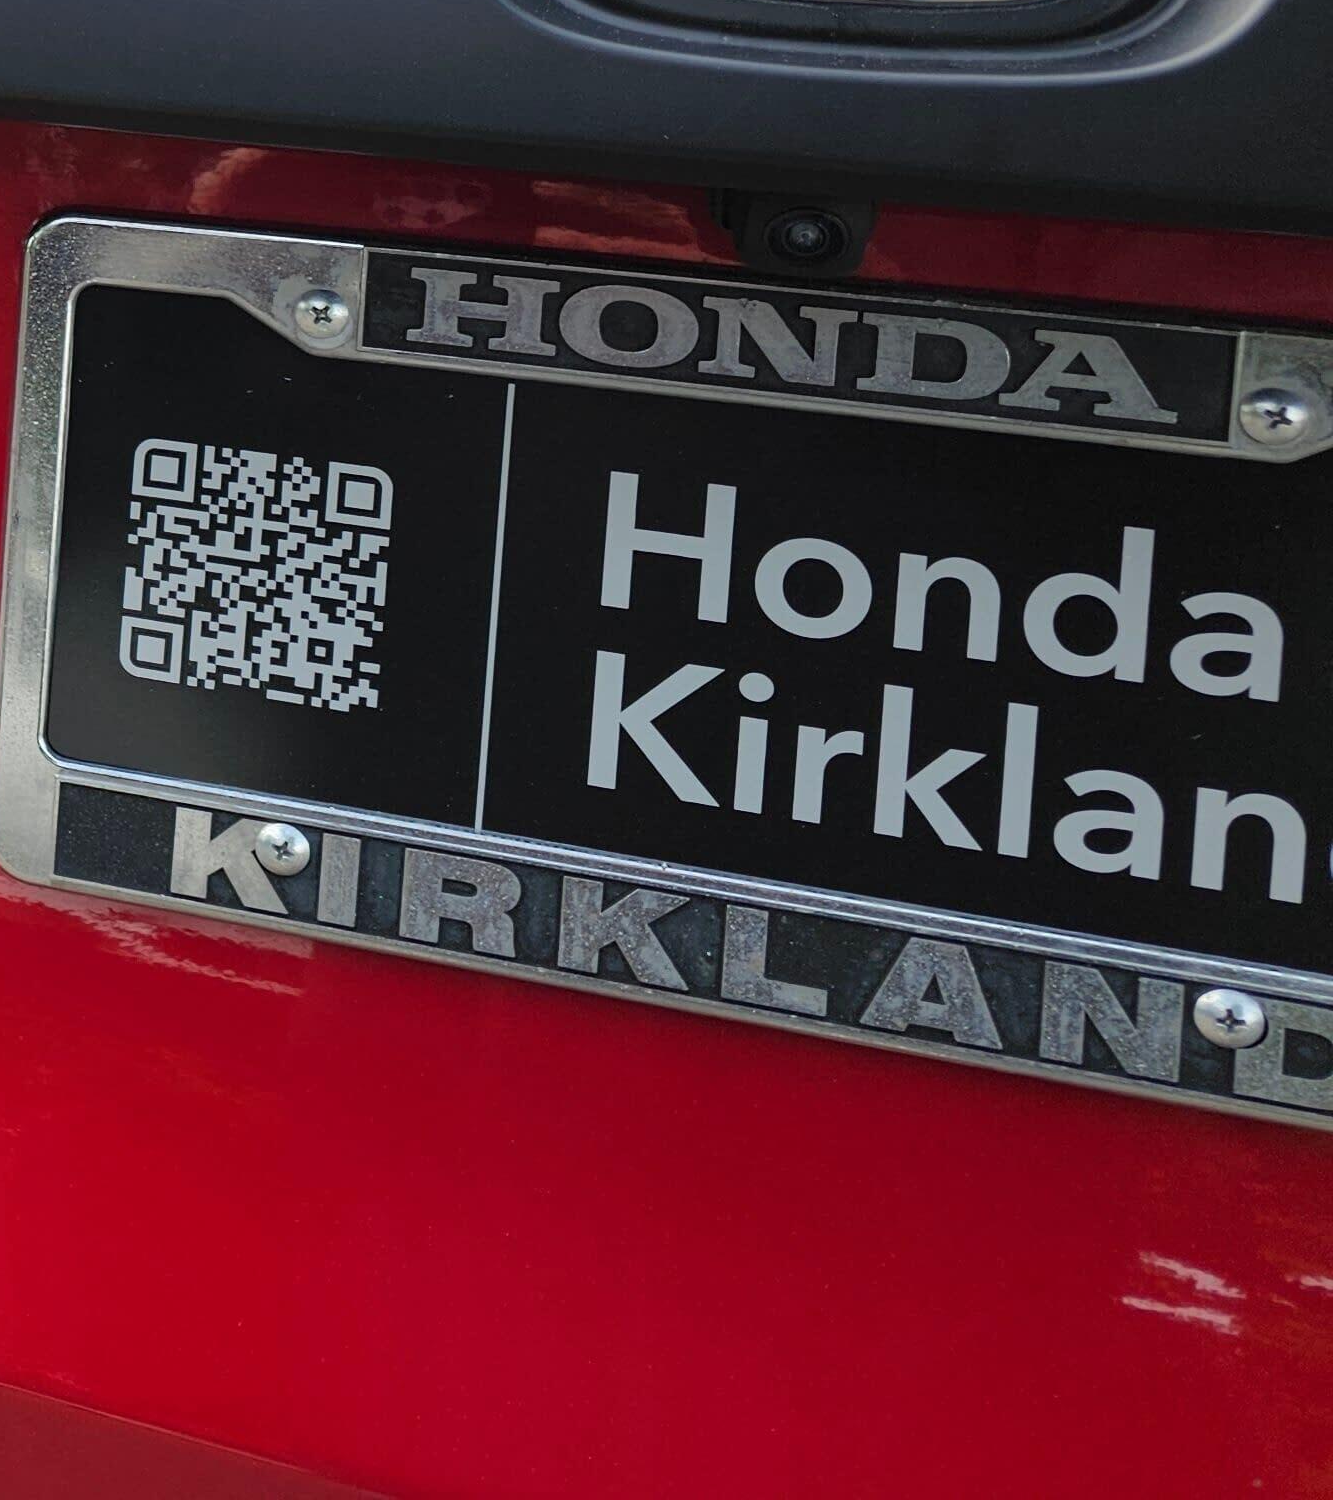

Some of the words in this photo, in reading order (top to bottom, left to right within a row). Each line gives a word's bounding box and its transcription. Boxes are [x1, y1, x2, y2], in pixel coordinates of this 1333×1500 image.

[407, 267, 1178, 424] HONDA
[600, 470, 1284, 702] Honda
[587, 650, 1333, 904] Kirklan
